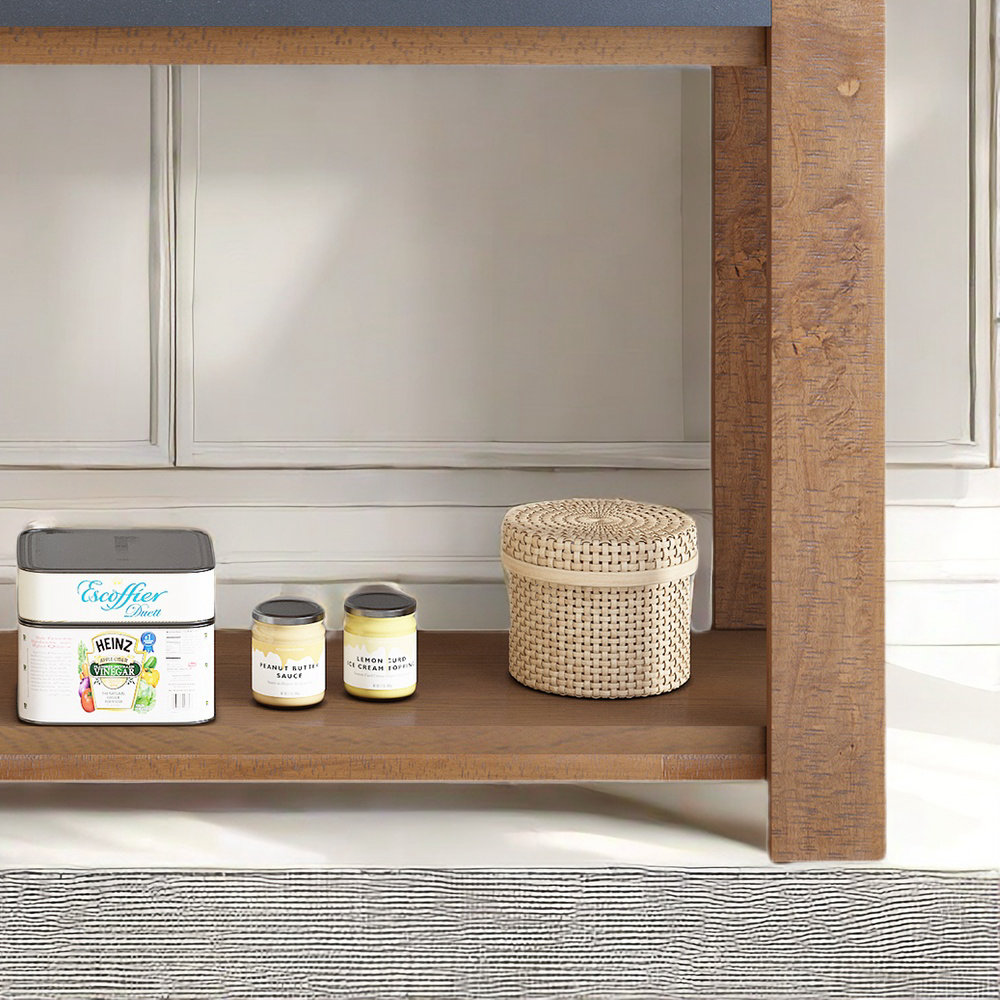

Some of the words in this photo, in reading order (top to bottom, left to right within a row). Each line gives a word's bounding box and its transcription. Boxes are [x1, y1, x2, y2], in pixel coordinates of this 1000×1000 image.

[77, 580, 169, 612] Escoffier
[124, 603, 162, 618] Duett
[96, 637, 133, 653] HEINZ
[356, 656, 383, 664] LEMON
[94, 666, 135, 676] VINEGAR
[260, 662, 288, 671] PEANUT
